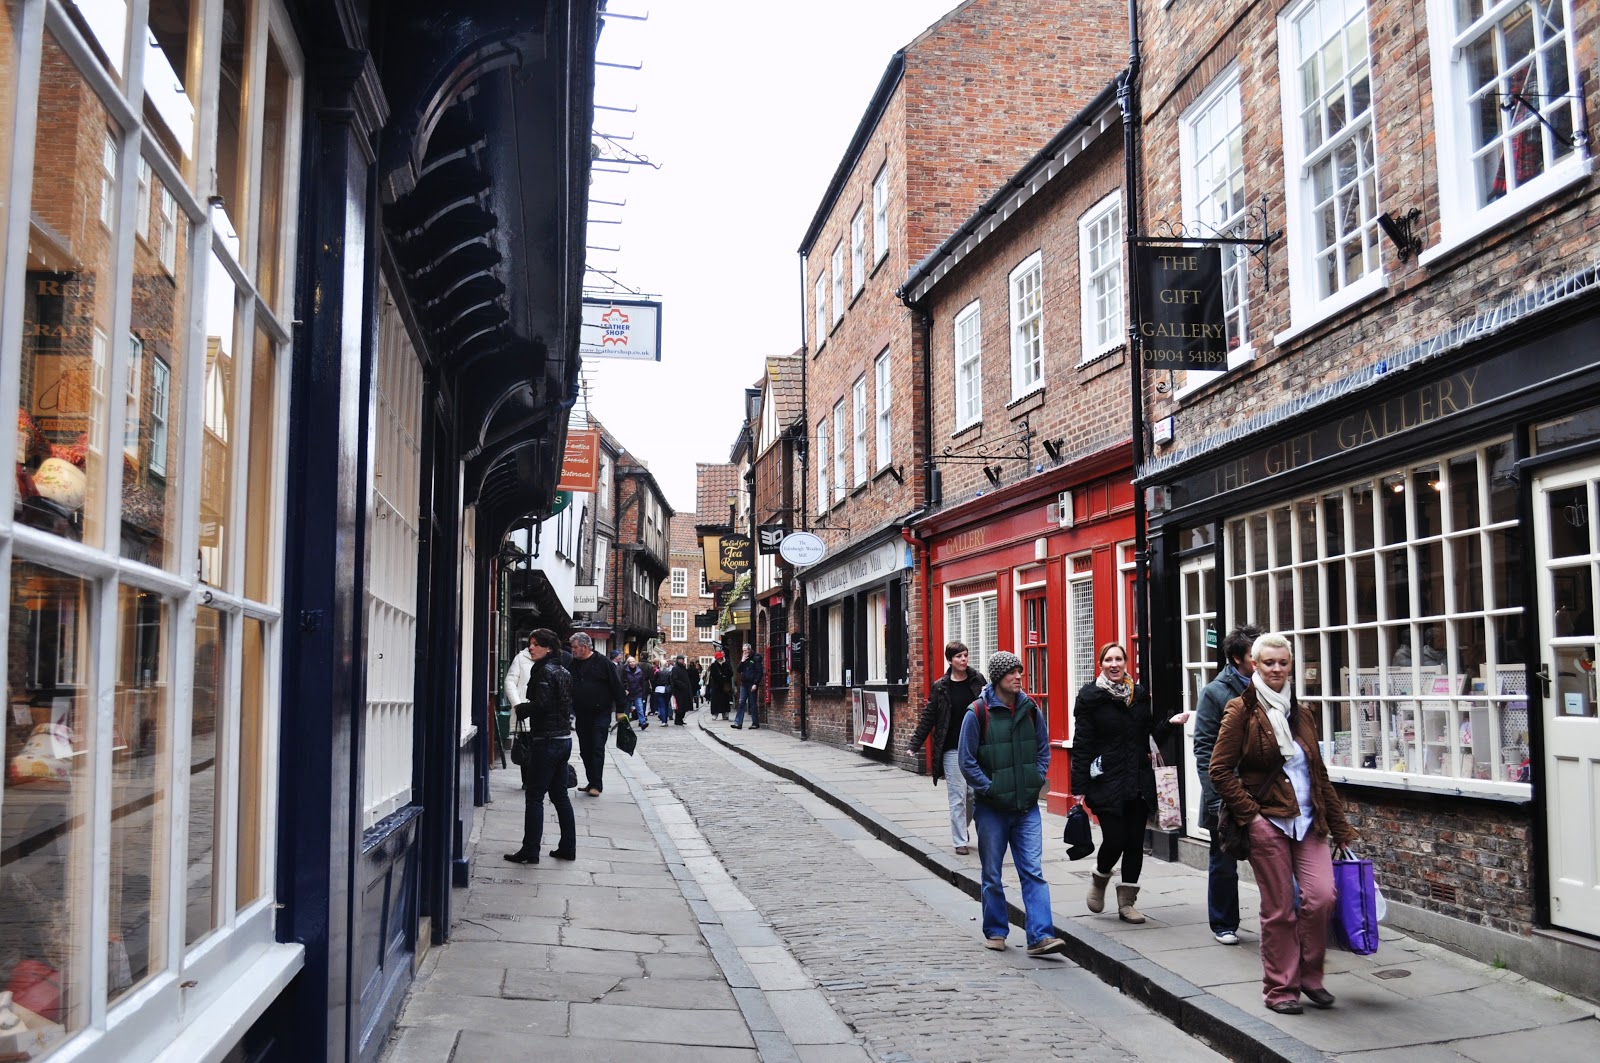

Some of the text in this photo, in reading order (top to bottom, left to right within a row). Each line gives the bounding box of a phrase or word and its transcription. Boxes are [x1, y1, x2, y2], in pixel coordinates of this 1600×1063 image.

[1158, 255, 1198, 271] THE
[1159, 289, 1202, 305] GIFT
[1140, 323, 1225, 339] GALLERY
[1143, 349, 1184, 362] 01904
[1213, 365, 1482, 495] THE GIFT GALLERY
[945, 527, 986, 555] GALLERY
[724, 546, 743, 558] Tea
[721, 557, 750, 570] Rooms
[819, 551, 882, 594] The Edinburgh Woollen Mill
